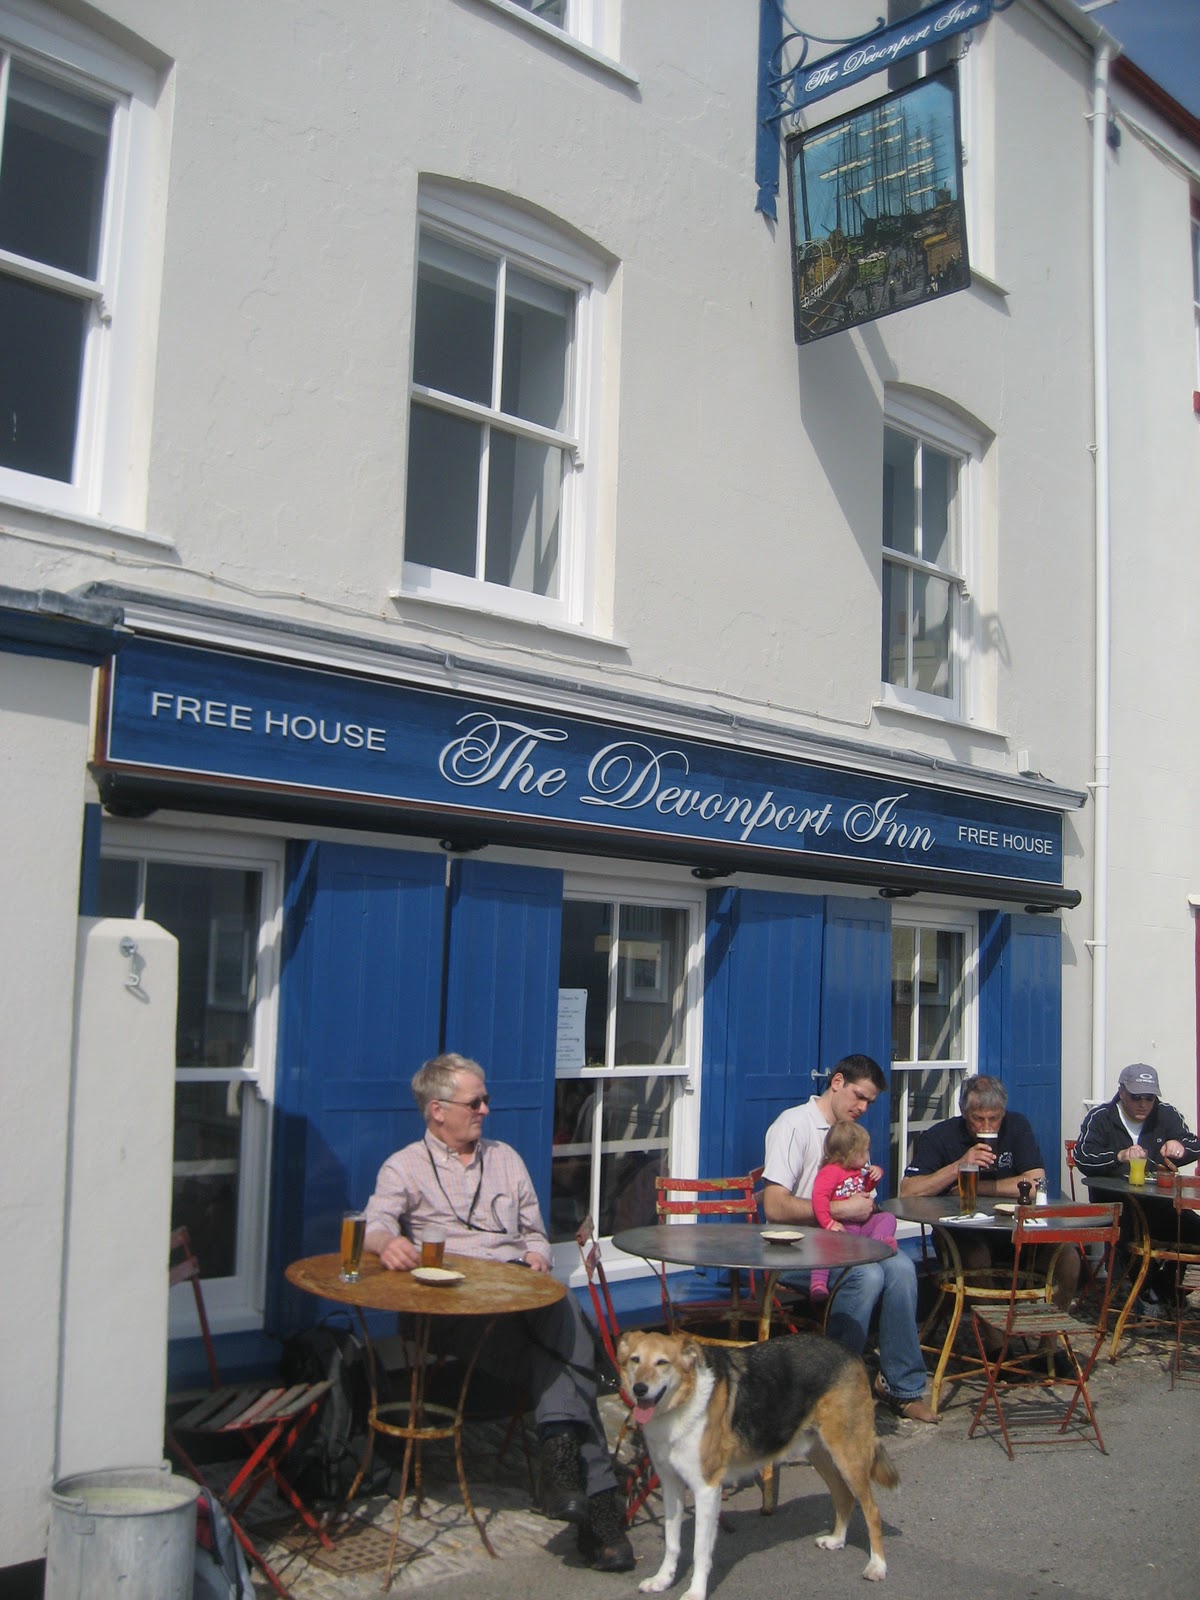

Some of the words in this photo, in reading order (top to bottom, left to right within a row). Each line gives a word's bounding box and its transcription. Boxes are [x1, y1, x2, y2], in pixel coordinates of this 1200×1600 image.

[805, 61, 839, 92] The
[841, 25, 931, 77] Devonport
[934, 1, 979, 32] Inn
[151, 691, 253, 731] FREE
[265, 710, 387, 751] HOUSE
[439, 712, 569, 797] The
[579, 741, 833, 841] Devonport
[843, 793, 936, 851] Inn
[958, 826, 999, 848] FREE
[1002, 833, 1053, 855] HOUSE
